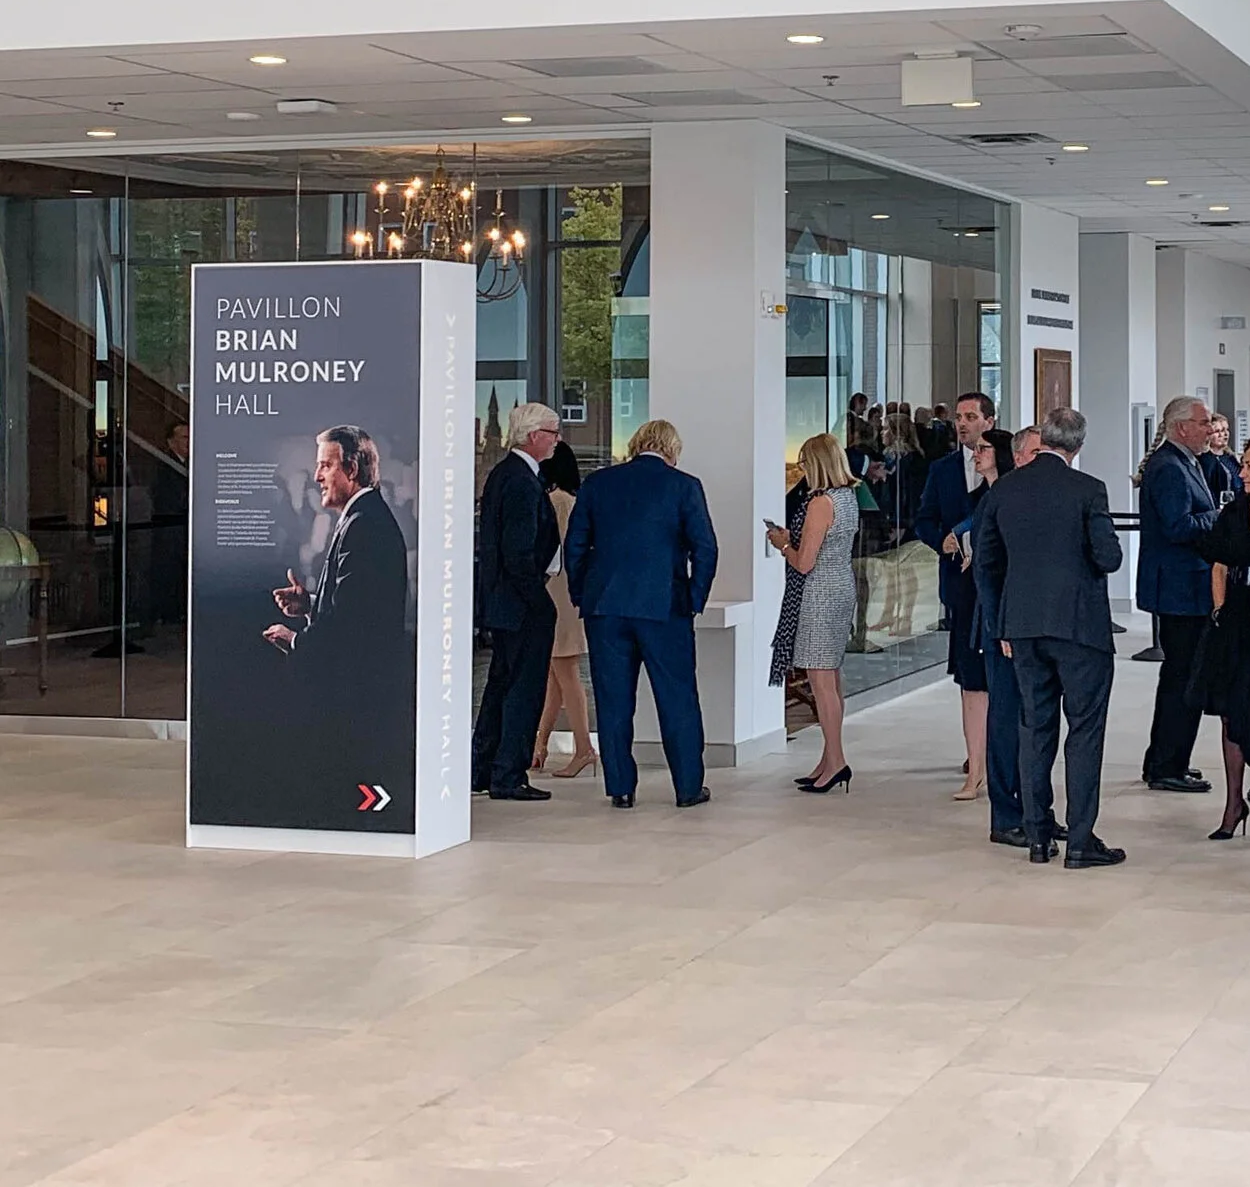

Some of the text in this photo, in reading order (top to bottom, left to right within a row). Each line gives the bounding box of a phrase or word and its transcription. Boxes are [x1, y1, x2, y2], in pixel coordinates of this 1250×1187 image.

[216, 296, 341, 319] PAVILLON
[215, 329, 297, 351] BRIAN
[215, 360, 365, 383] MULRONEY
[215, 393, 279, 415] HALL
[440, 335, 456, 779] PAVILLON BRIAN MULRONEY HALL
